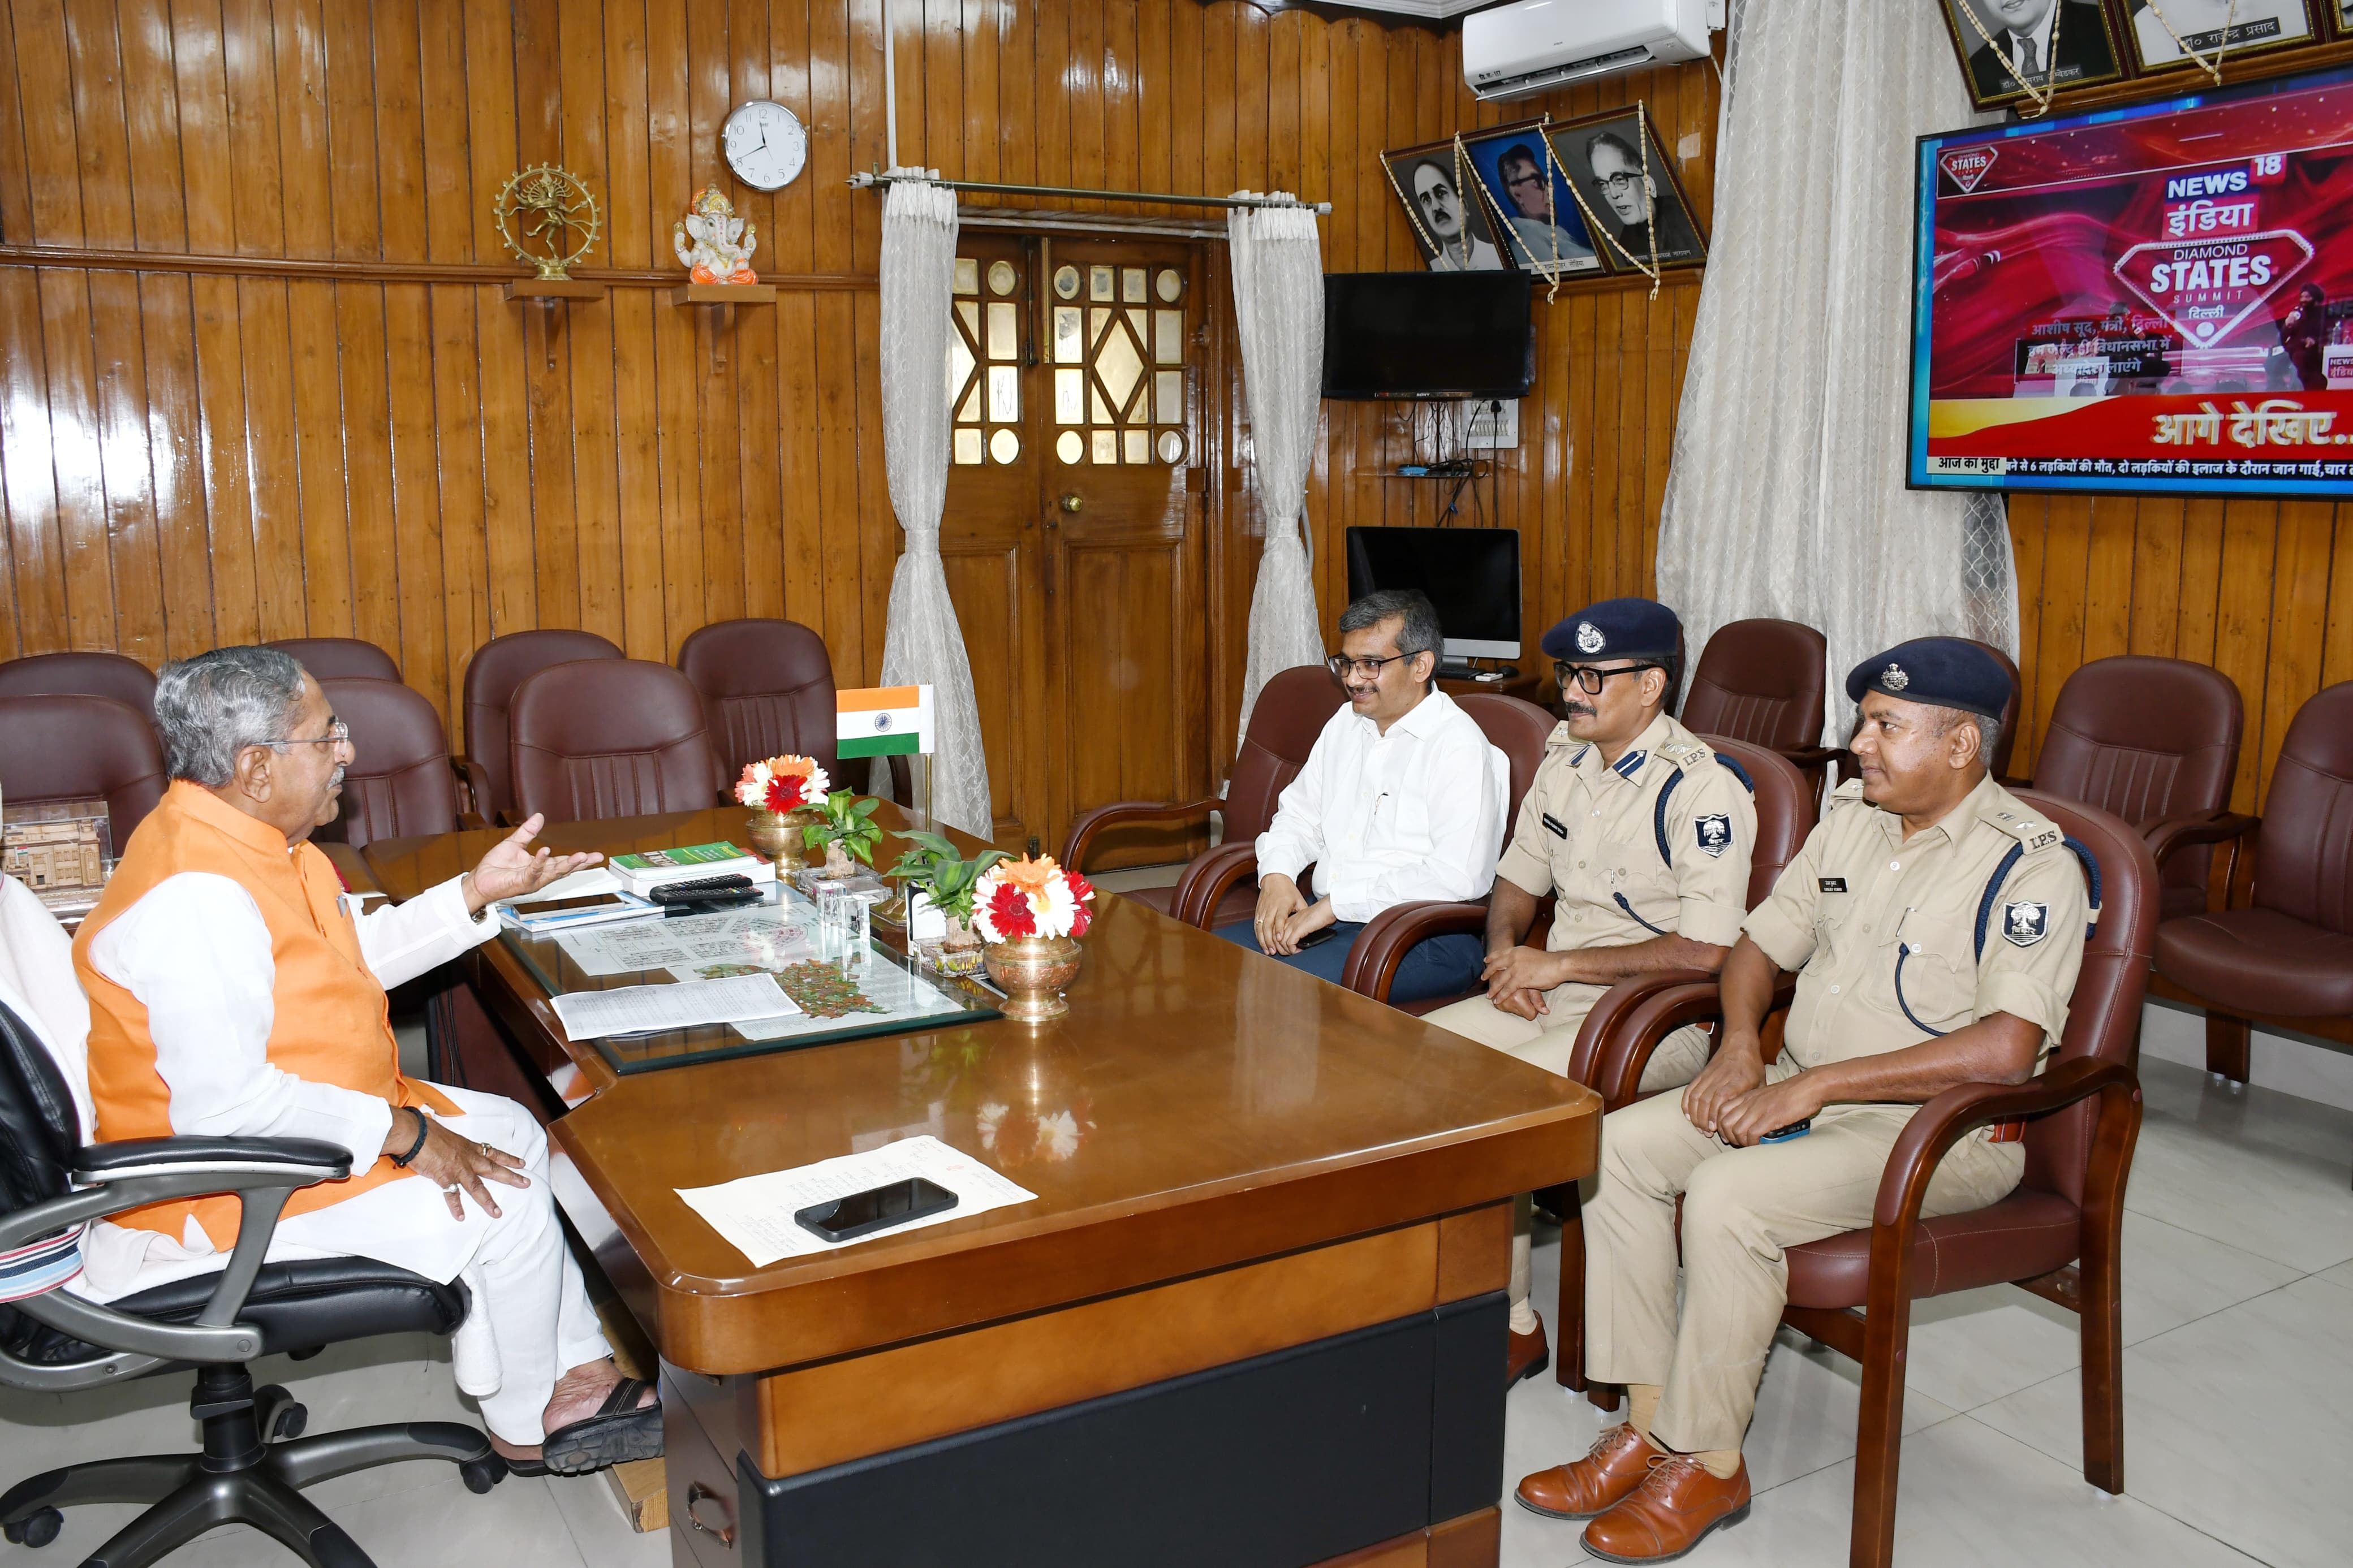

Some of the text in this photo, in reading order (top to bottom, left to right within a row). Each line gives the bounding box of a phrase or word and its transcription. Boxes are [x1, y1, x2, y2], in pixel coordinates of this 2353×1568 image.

[2246, 21, 2275, 36] प्रसाद
[745, 113, 752, 123] 11
[759, 108, 768, 119] 12
[734, 126, 744, 135] 10
[787, 124, 794, 135] 2
[793, 141, 800, 152] 3
[736, 157, 743, 167] 8
[789, 158, 795, 167] 4
[1951, 156, 1986, 171] STATES
[748, 168, 755, 178] 7
[764, 174, 770, 183] 6
[778, 169, 785, 179] 5
[2167, 155, 2282, 198] NEWS 18
[2167, 200, 2255, 237] इंडिया
[2174, 244, 2248, 261] DIAMOND
[2150, 255, 2272, 293] STATES
[2173, 290, 2243, 304] SUMMIT
[2188, 304, 2225, 319] दिल्ली
[2032, 319, 2070, 335] आशीष
[2151, 401, 2224, 445] आगे
[1938, 457, 2001, 473] आज का मुद्दा
[2019, 458, 2029, 472] से
[2030, 462, 2036, 472] 6
[2039, 459, 2078, 474] लड़कियों
[2079, 459, 2092, 473] की
[2094, 459, 2116, 475] मौत,
[2118, 459, 2130, 473] दो
[2131, 459, 2174, 476] लड़कियों
[2175, 459, 2190, 474] की
[2192, 463, 2225, 476] इलाज
[2225, 460, 2238, 474] के
[2239, 460, 2271, 476] दौरान
[2272, 463, 2298, 475] जान
[2011, 925, 2037, 935] बिहार
